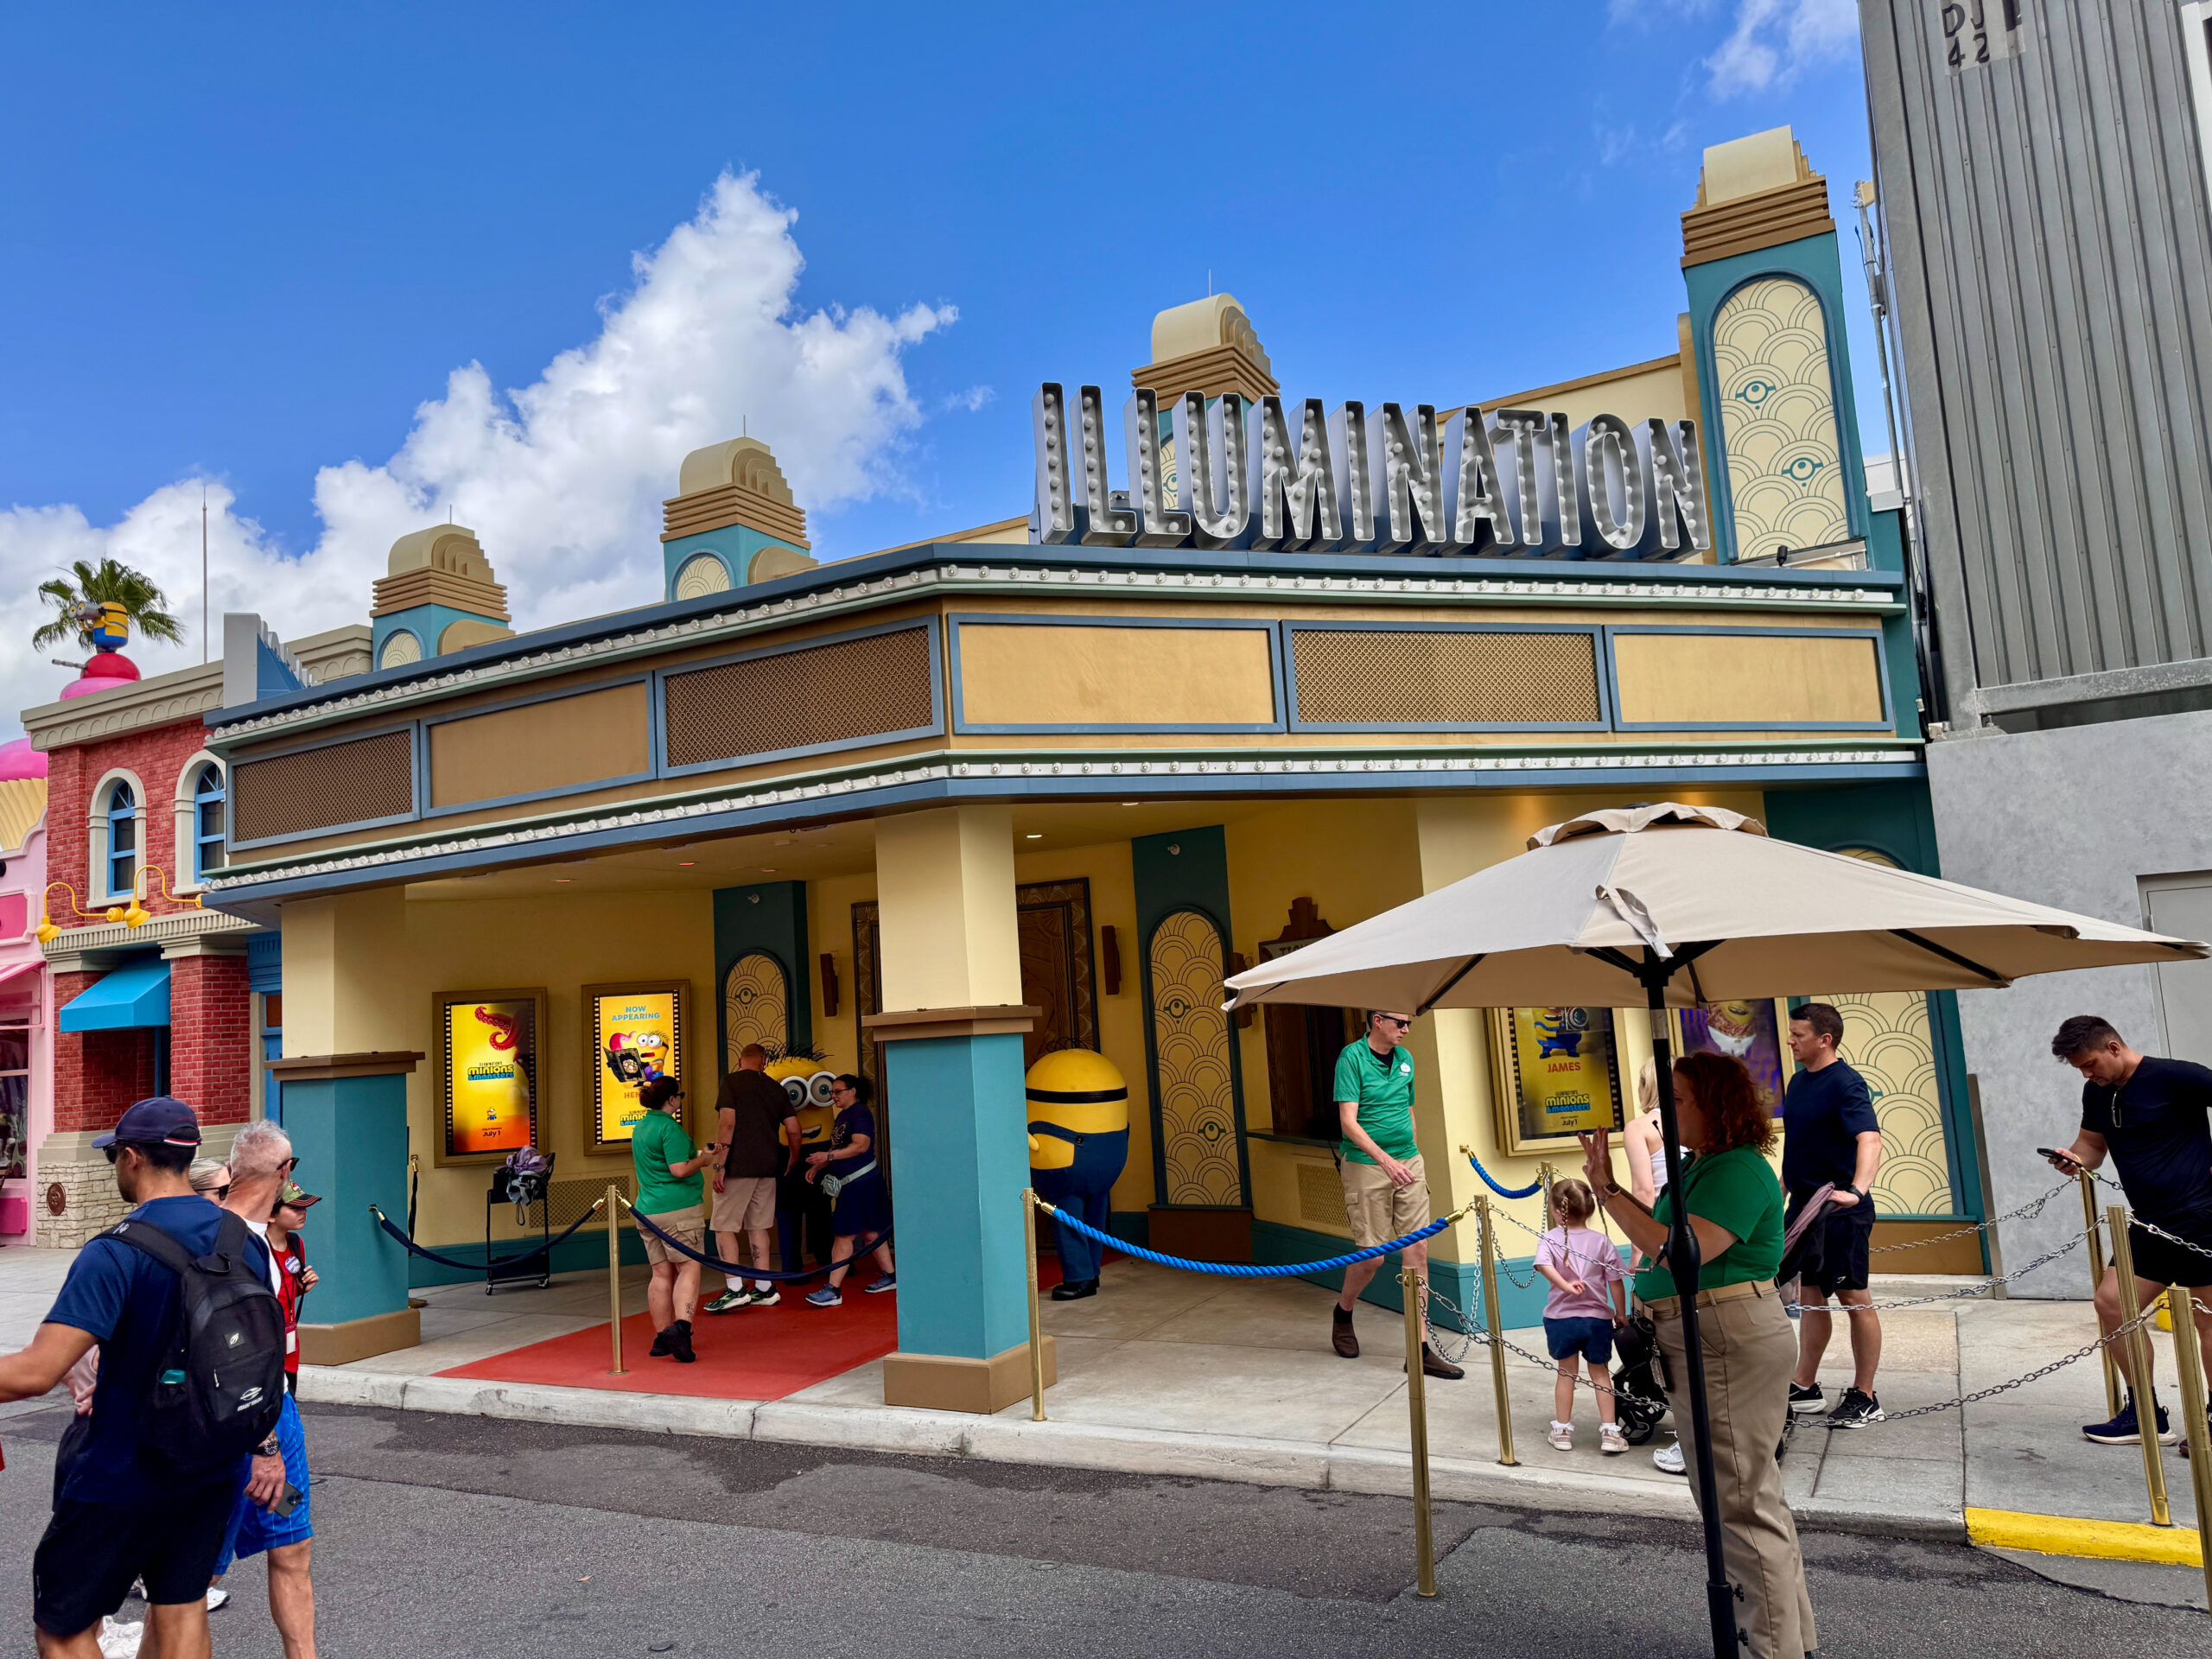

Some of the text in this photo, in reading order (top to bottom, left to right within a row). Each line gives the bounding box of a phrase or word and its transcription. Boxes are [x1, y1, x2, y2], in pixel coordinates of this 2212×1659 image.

[1948, 32, 1990, 68] 42
[1033, 382, 1712, 553] ILLUMINATION
[612, 1013, 661, 1021] APPEARING
[467, 1065, 513, 1075] minions
[1548, 1062, 1580, 1072] JAMES
[1545, 1094, 1589, 1106] minions
